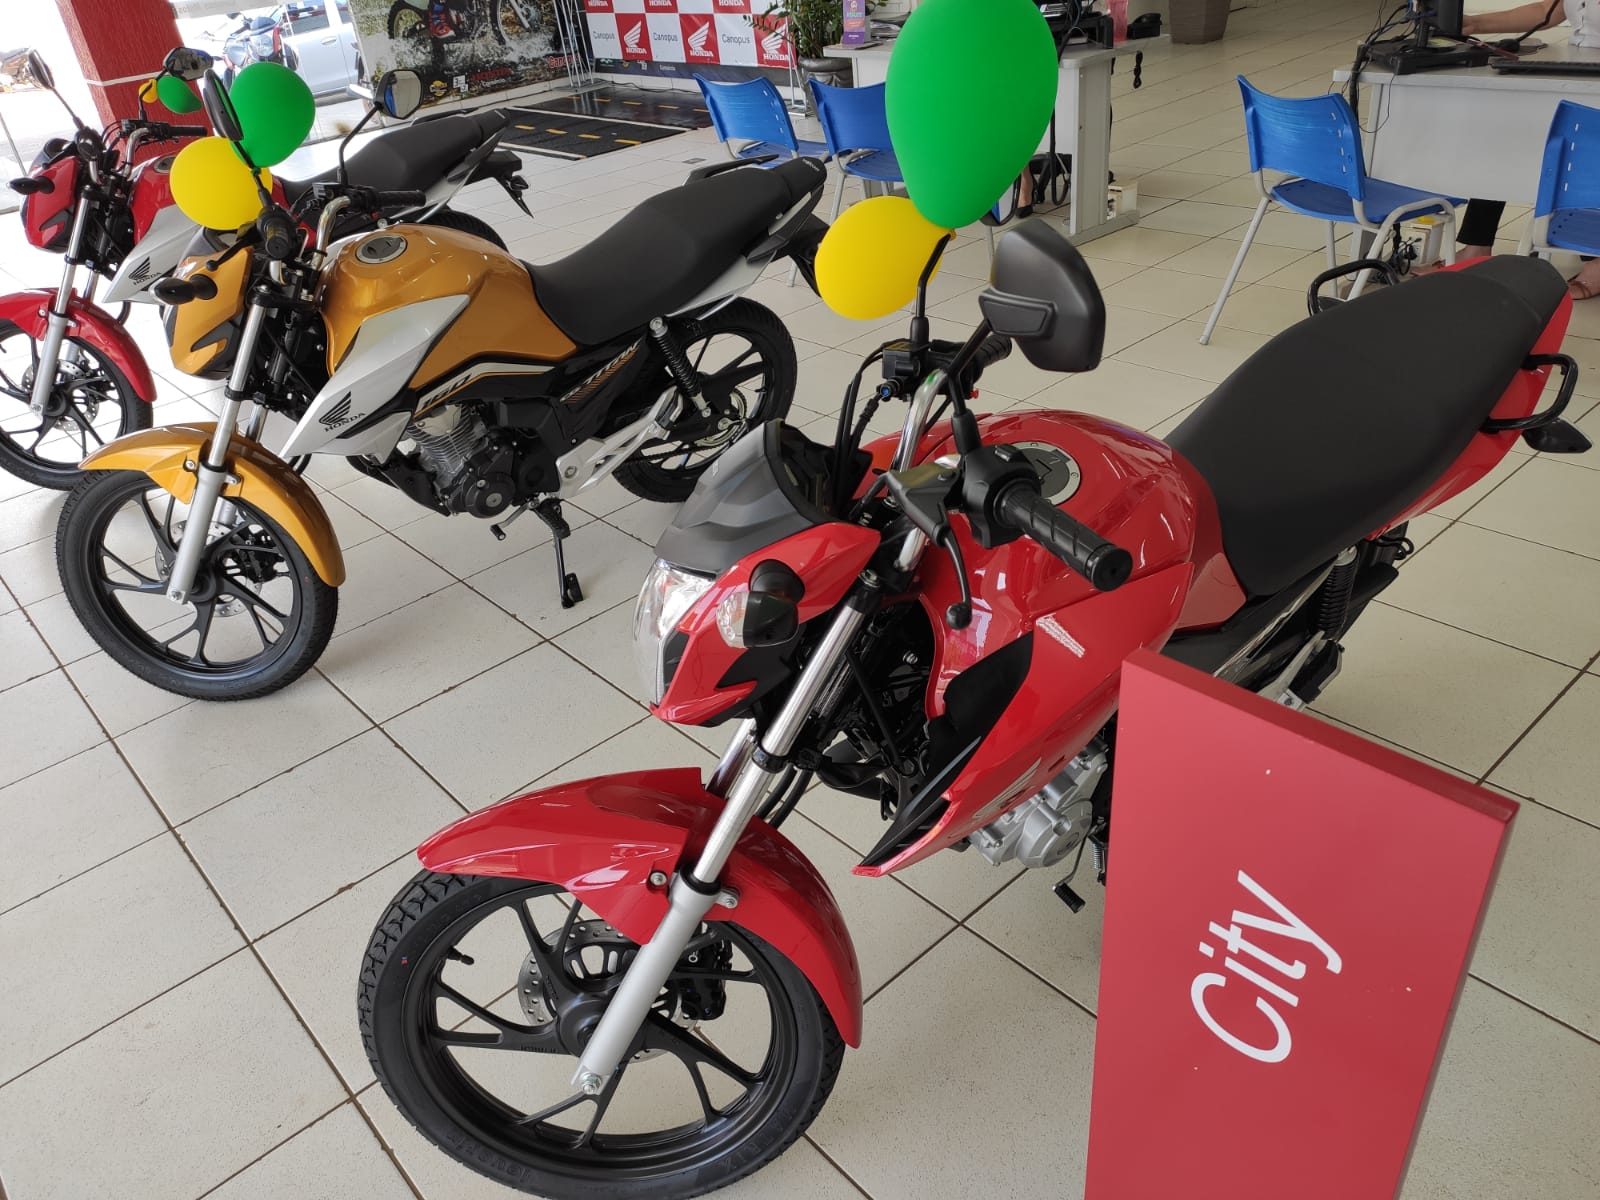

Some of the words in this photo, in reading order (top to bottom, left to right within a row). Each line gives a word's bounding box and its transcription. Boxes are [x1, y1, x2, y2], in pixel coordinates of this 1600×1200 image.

[593, 31, 615, 40] Canopus
[653, 33, 678, 42] Canopus
[722, 34, 750, 46] Canopus
[626, 46, 647, 54] HONDA
[763, 53, 790, 61] HONDA
[133, 272, 161, 285] HONDA
[324, 412, 366, 432] HONDA
[1190, 869, 1343, 1064] City
